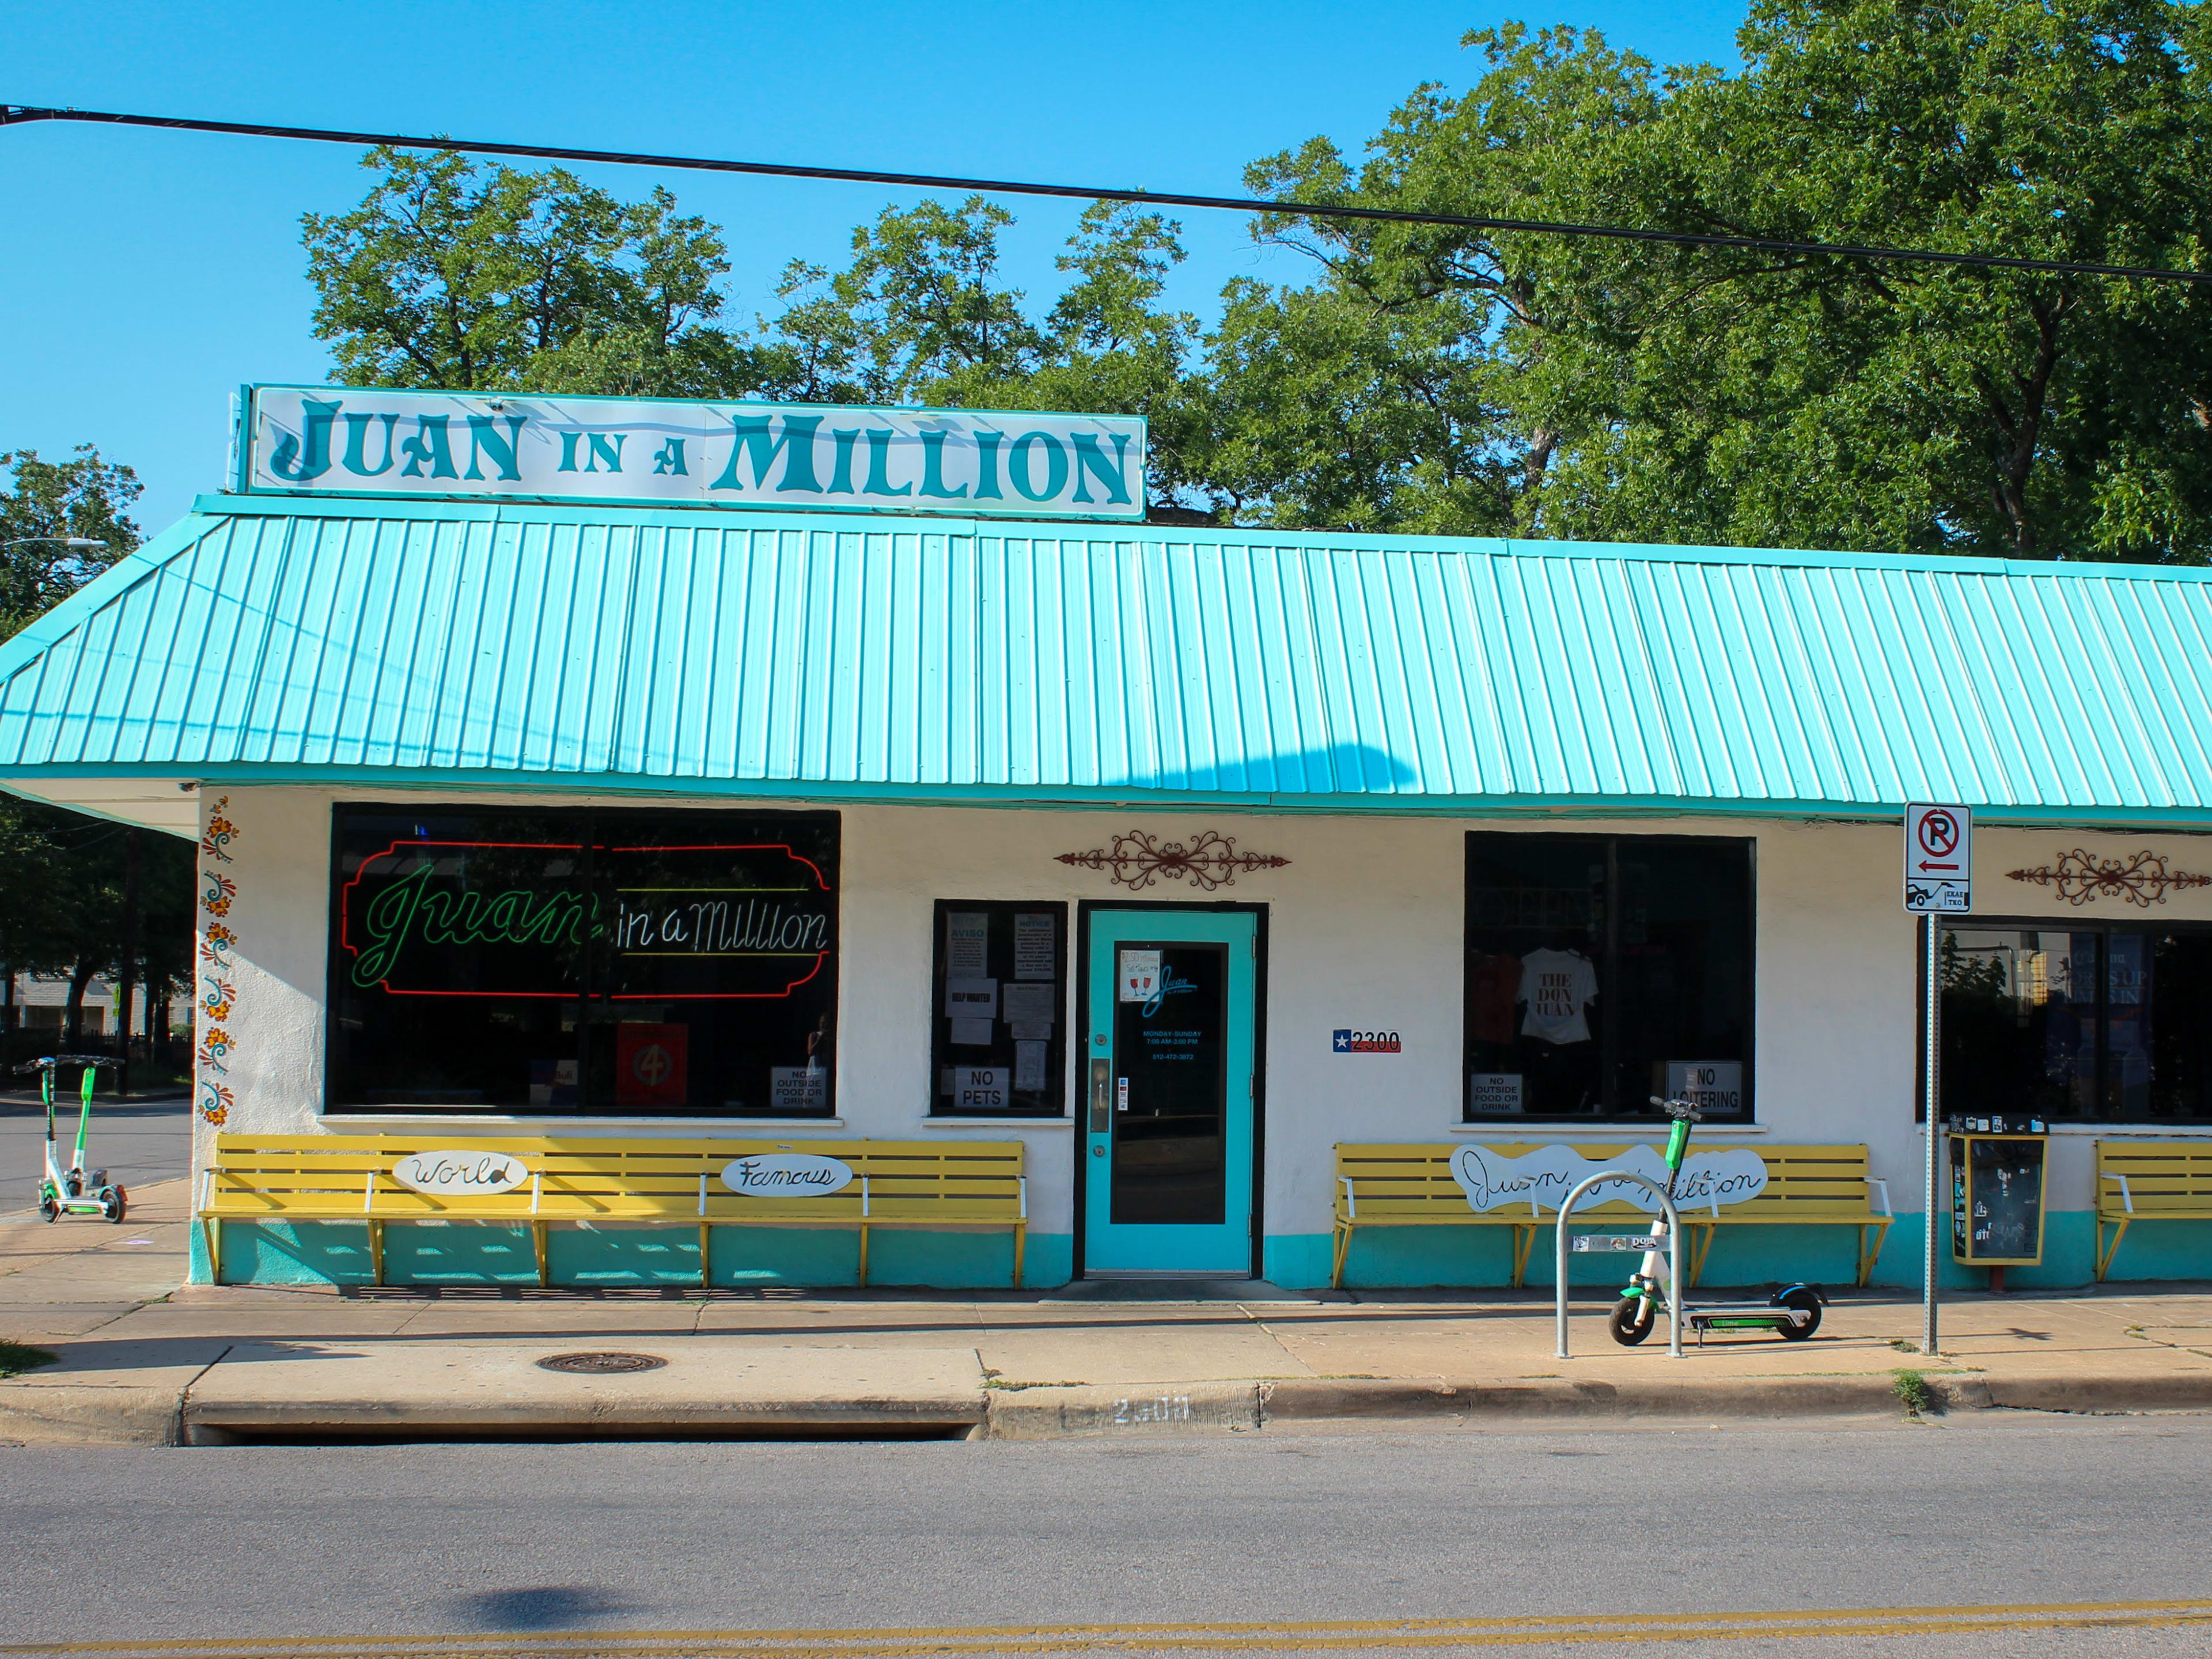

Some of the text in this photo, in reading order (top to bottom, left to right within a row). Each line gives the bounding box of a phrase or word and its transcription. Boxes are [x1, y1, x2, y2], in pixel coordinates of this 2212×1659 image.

[270, 399, 1132, 505] JUAN IN A MILLION
[616, 903, 653, 948] in
[662, 908, 688, 943] a
[952, 929, 984, 937] AVISO
[1539, 973, 1571, 987] THE
[1539, 988, 1571, 1002] DON
[1536, 1003, 1575, 1016] JUAN
[1353, 1032, 1399, 1050] 2300
[640, 1043, 664, 1087] 4
[971, 1071, 993, 1085] NO
[1697, 1068, 1715, 1085] NO
[963, 1090, 1001, 1105] PETS
[411, 1156, 513, 1184] World
[739, 1161, 836, 1187] Famous
